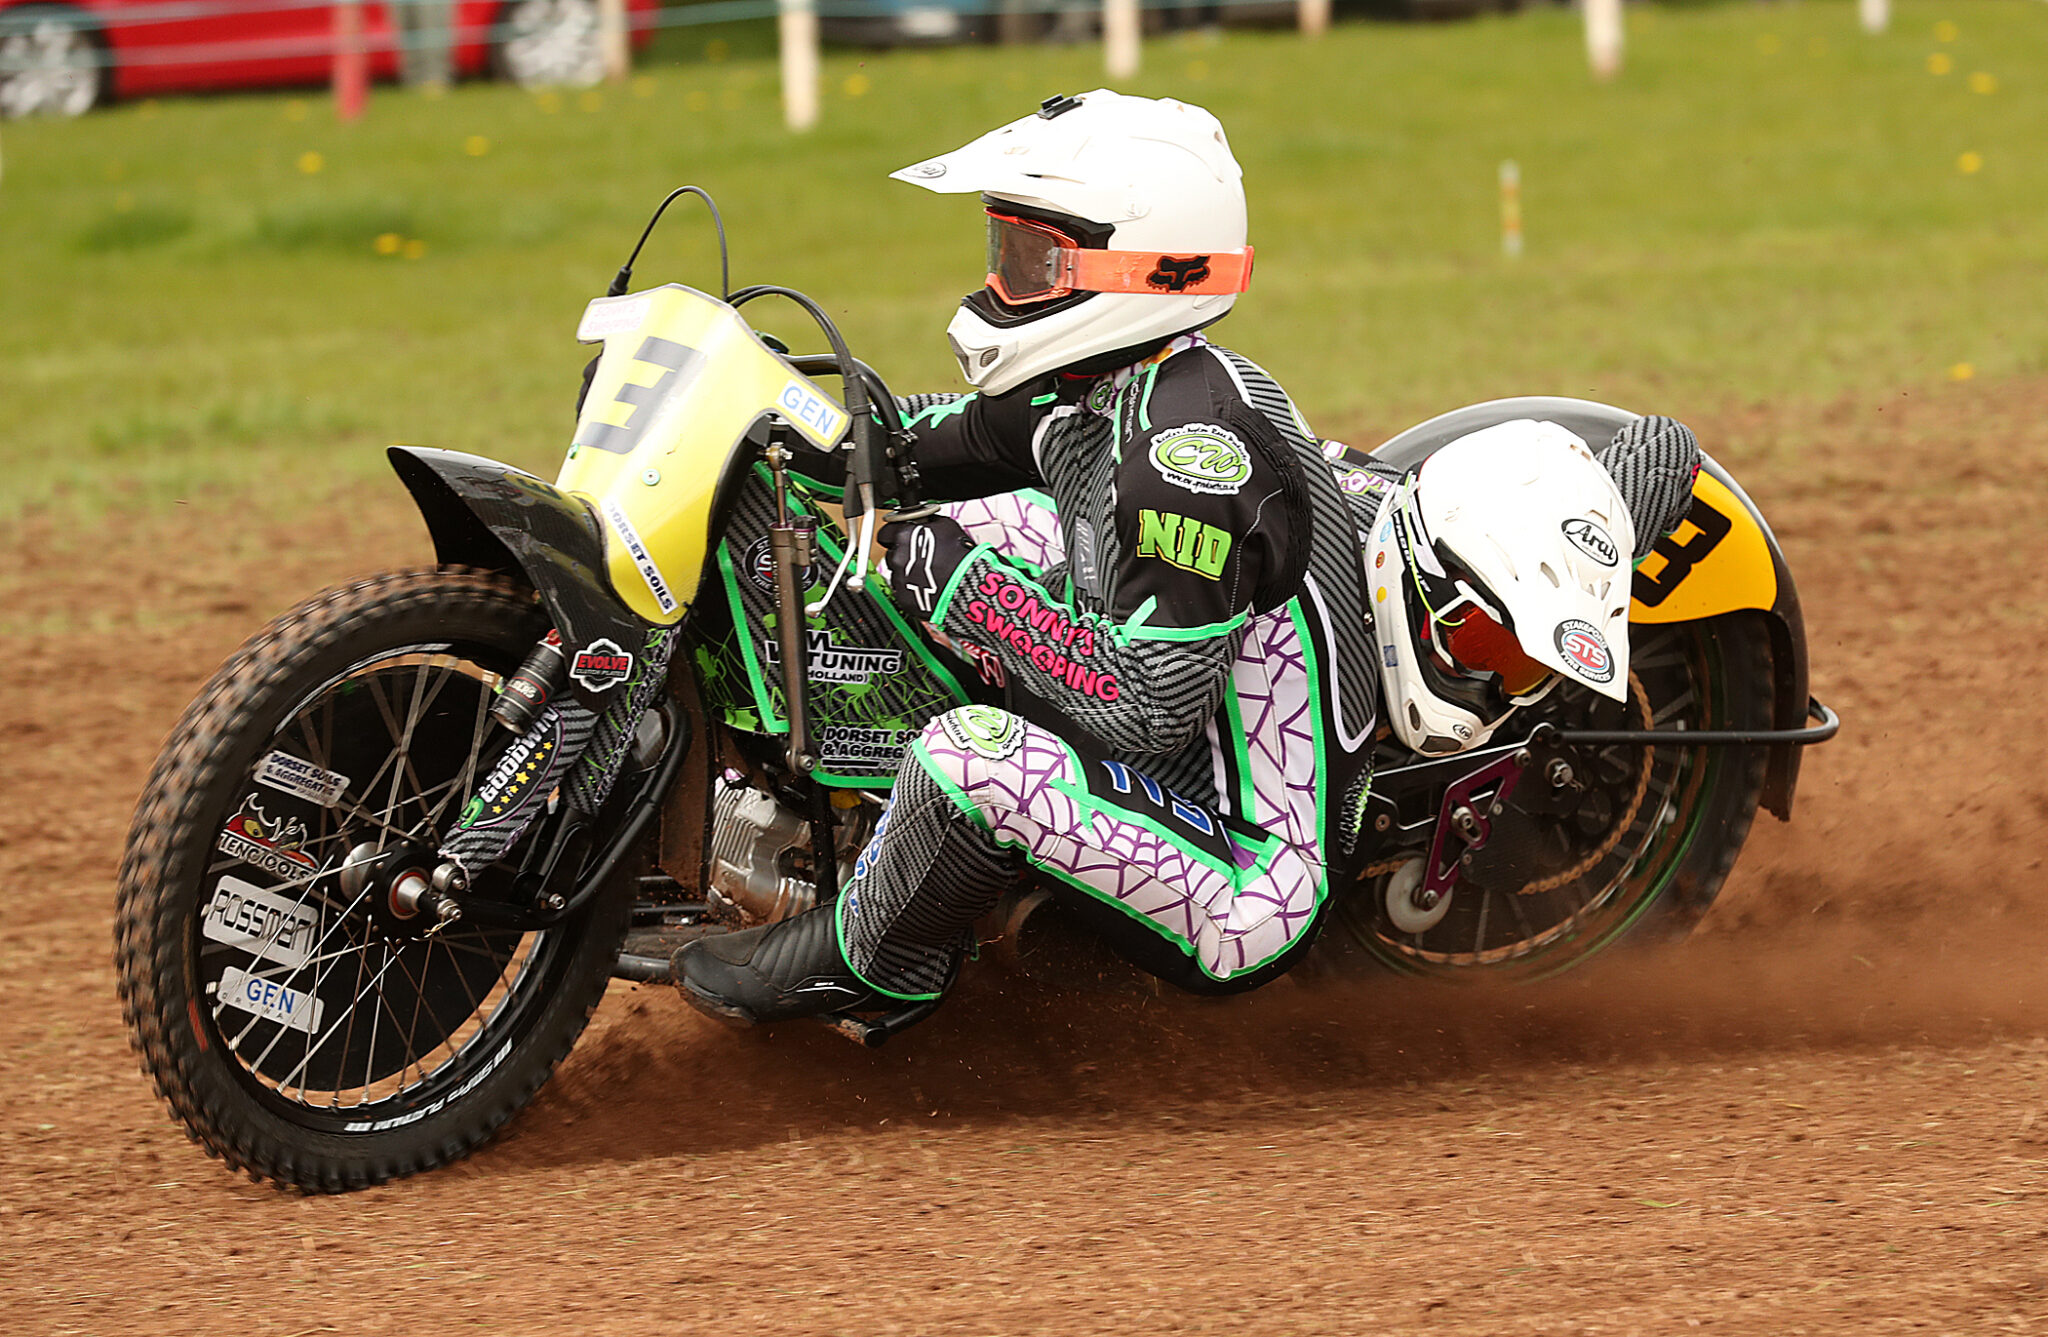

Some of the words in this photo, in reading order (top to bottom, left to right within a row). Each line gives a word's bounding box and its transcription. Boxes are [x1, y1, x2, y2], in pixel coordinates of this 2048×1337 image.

[578, 336, 706, 455] 3
[783, 386, 835, 434] GEN
[1566, 525, 1613, 560] Arai
[643, 566, 673, 610] SOILS
[979, 573, 1094, 657] SONNY'S
[577, 655, 629, 671] EVOLVE
[808, 652, 899, 672] TUNING
[1565, 635, 1607, 666] STS
[823, 743, 836, 756] &
[839, 744, 905, 759] AGGREG
[826, 728, 892, 744] DORSET
[270, 754, 311, 774] DORSET
[311, 768, 342, 787] SOILS
[480, 706, 560, 803] GOODWIN
[246, 978, 296, 1014] GEN
